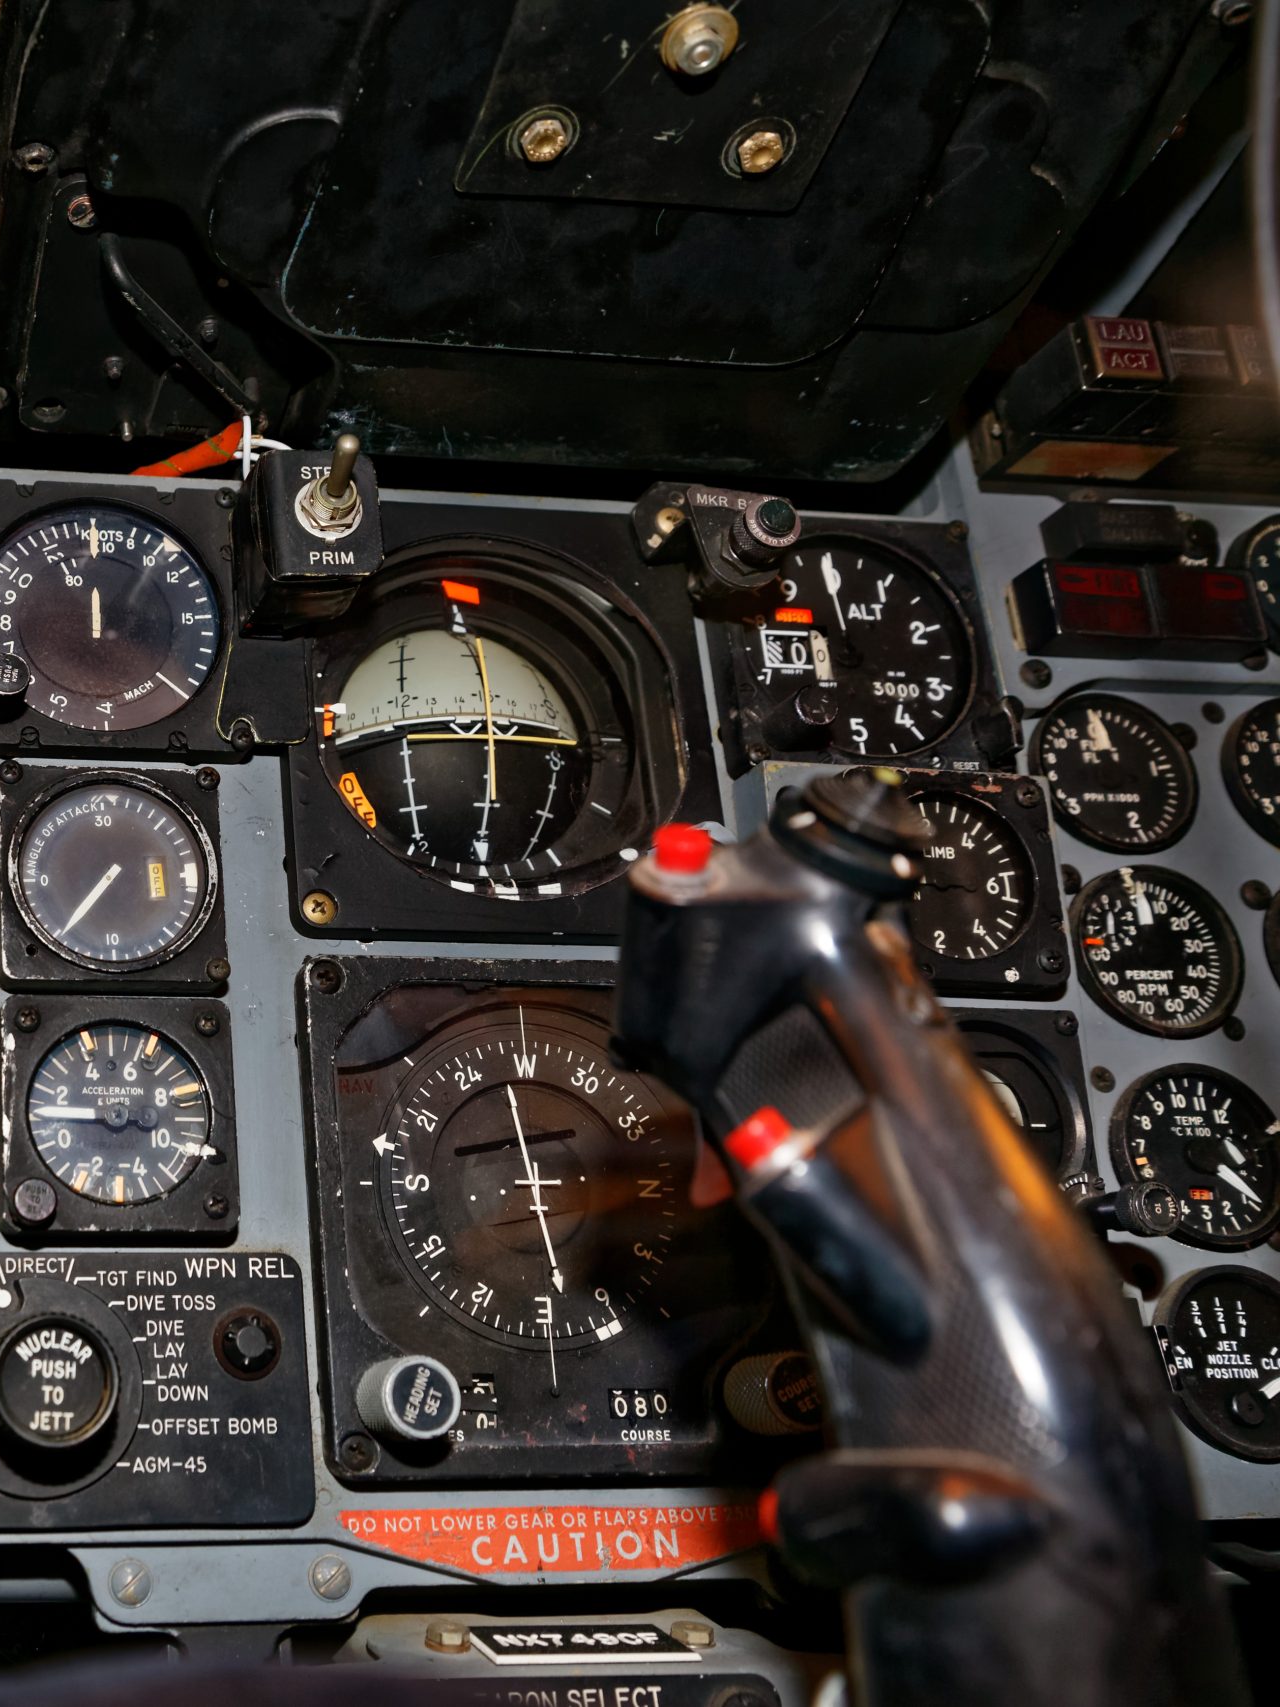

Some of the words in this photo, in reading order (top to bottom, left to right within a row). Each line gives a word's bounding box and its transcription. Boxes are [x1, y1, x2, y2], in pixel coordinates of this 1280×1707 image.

[696, 493, 729, 507] MKR
[81, 529, 124, 542] KOTS
[143, 555, 156, 567] 10
[309, 551, 355, 565] PRIM
[65, 575, 83, 587] 80
[182, 612, 194, 624] 15
[848, 603, 883, 620] ALT
[909, 621, 928, 645] 2
[124, 680, 154, 701] MACH
[872, 681, 920, 698] 3000
[849, 718, 869, 742] 5
[94, 815, 112, 827] 30
[26, 839, 45, 876] ANGLE
[43, 823, 55, 838] OF
[56, 802, 98, 826] ATTACK
[151, 865, 163, 897] OFF
[1170, 918, 1189, 931] 20
[1184, 939, 1203, 953] 30
[1099, 972, 1118, 985] 90
[1125, 970, 1174, 981] PERCENT
[1187, 965, 1207, 979] 40
[1137, 983, 1169, 996] RPM
[123, 1063, 137, 1081] 6
[514, 1053, 537, 1078] W
[454, 1067, 483, 1091] 24
[570, 1070, 600, 1095] 30
[82, 1086, 144, 1096] ACCELERATION
[155, 1087, 168, 1106] 8
[416, 1109, 439, 1133] 21
[618, 1112, 646, 1143] 33
[151, 1129, 171, 1148] 10
[1195, 1128, 1212, 1137] 100
[404, 1173, 430, 1193] S
[5, 1257, 67, 1275] DIRECT
[184, 1257, 237, 1279] WPN
[249, 1257, 295, 1279] REL
[97, 1271, 128, 1287] TGT
[136, 1270, 178, 1287] FIND
[126, 1295, 165, 1311] DIVE
[172, 1294, 216, 1311] TOSS
[146, 1320, 185, 1337] DIVE
[18, 1330, 93, 1365] NUCLEAR
[153, 1342, 185, 1359] LAY
[1216, 1341, 1238, 1352] JET
[1207, 1354, 1253, 1365] NOZZLE
[31, 1359, 77, 1380] PUSH
[156, 1363, 188, 1380] LAY
[1206, 1368, 1260, 1379] POSITION
[41, 1384, 64, 1405] TO
[157, 1384, 209, 1402] DOWN
[402, 1366, 431, 1424] HEADING
[424, 1386, 442, 1417] SET
[614, 1393, 668, 1418] 080
[28, 1411, 74, 1432] JETT
[151, 1418, 220, 1436] OFFSET
[228, 1418, 278, 1436] BOMB
[620, 1429, 672, 1442] COURSE
[132, 1456, 207, 1474] AGM-45
[347, 1517, 377, 1534] DO
[384, 1515, 422, 1534] NOT
[431, 1513, 496, 1532] LOWER
[505, 1511, 555, 1530] GEAR
[561, 1511, 588, 1529] OR
[593, 1509, 649, 1528] FLAPS
[655, 1506, 719, 1526] ABOVE
[471, 1528, 680, 1567] CAUTION
